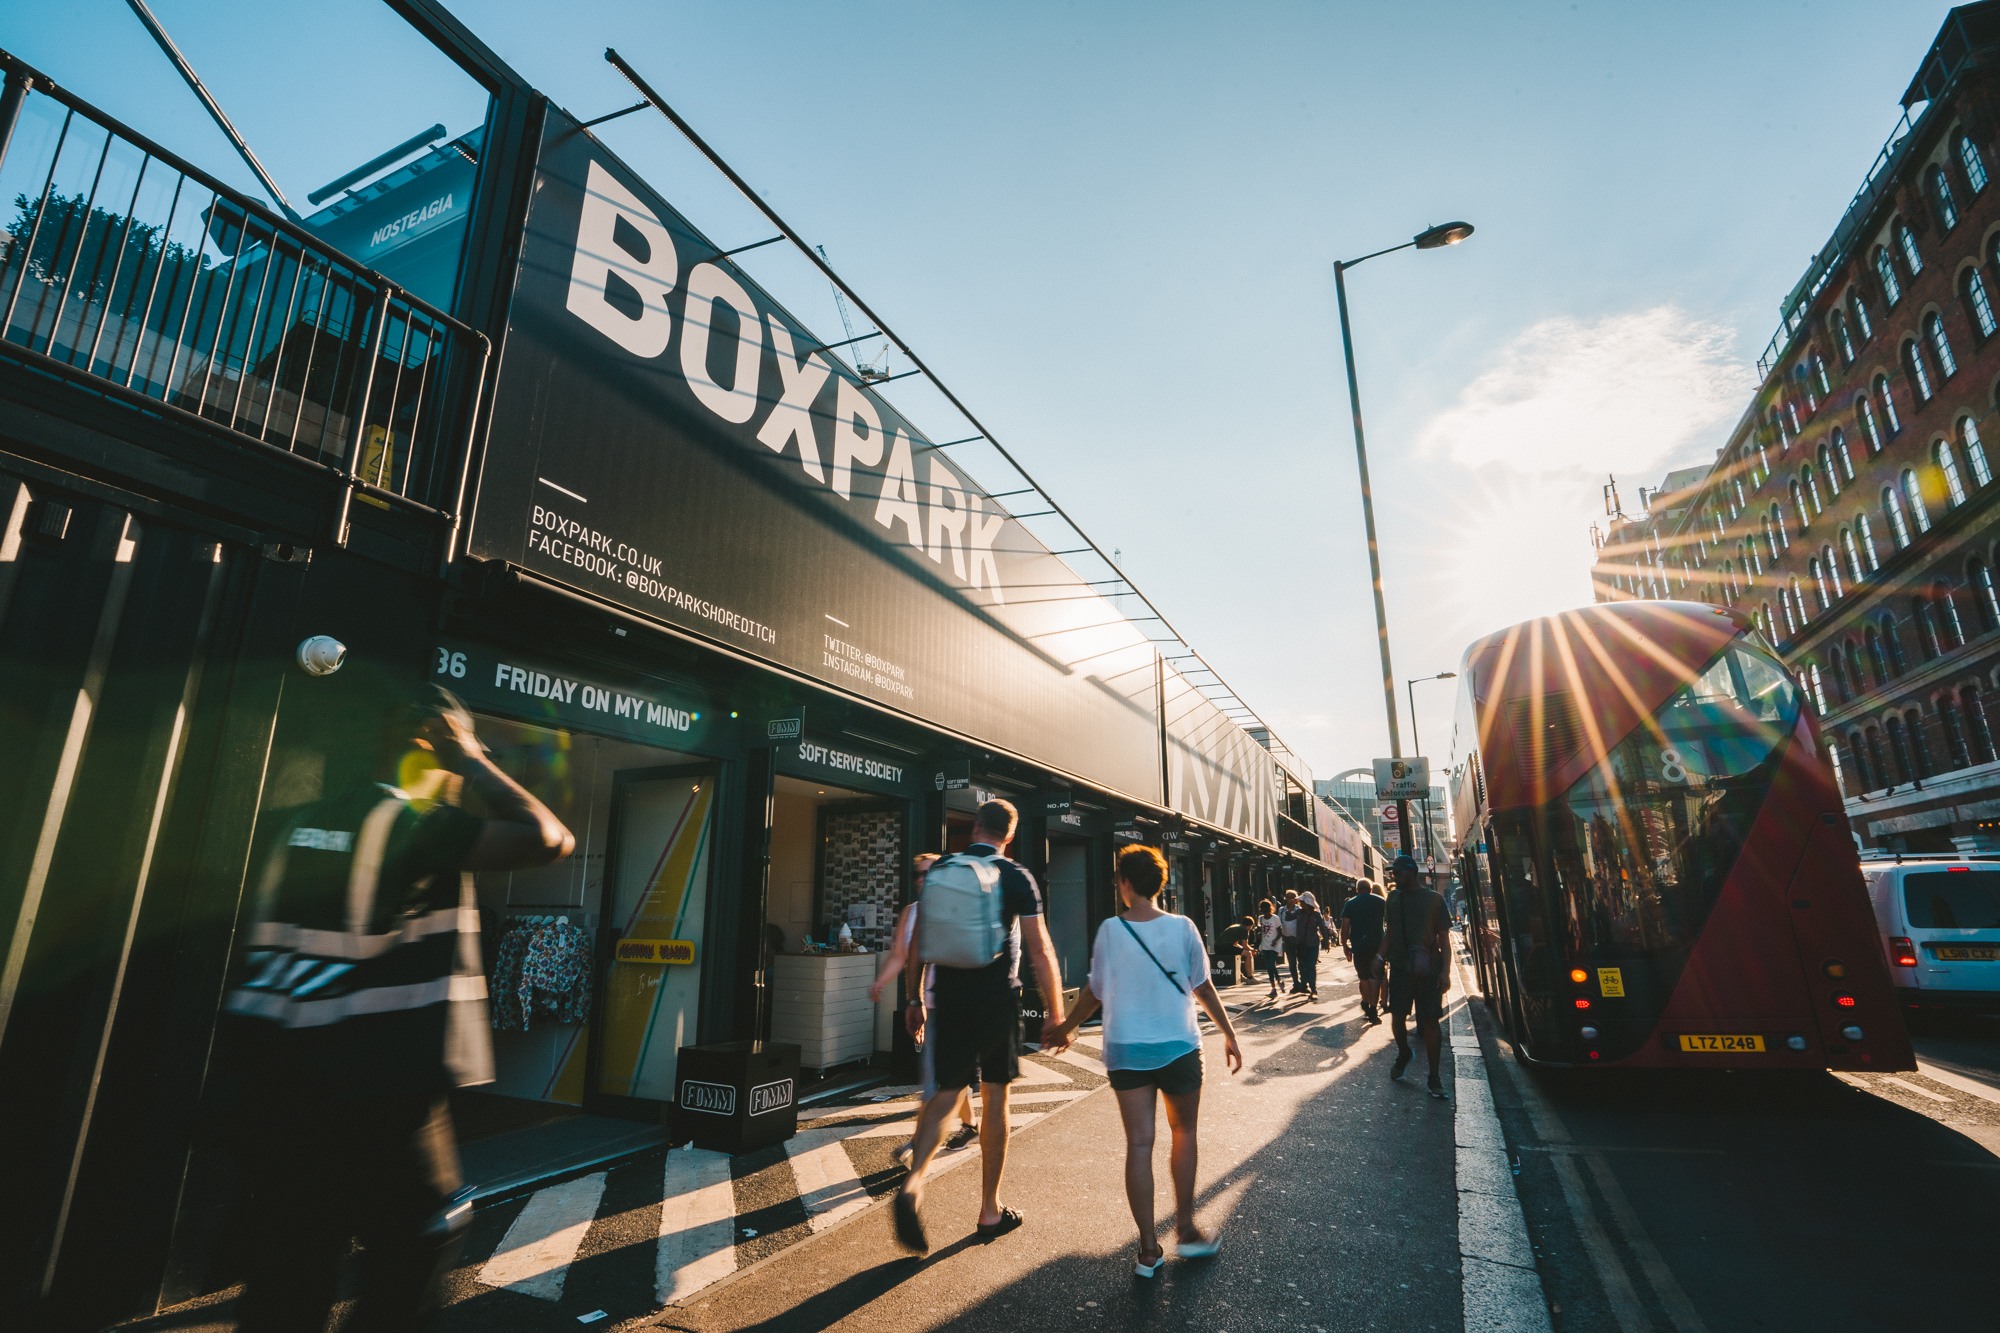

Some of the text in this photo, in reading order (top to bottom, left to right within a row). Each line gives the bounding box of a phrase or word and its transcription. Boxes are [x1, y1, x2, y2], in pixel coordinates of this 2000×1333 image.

[370, 193, 453, 247] NOSTEAGIA
[566, 159, 1005, 607] BOXPARK
[532, 505, 662, 577] BOXPARK.CO.UK
[529, 530, 776, 645] FACEBOOK: @BOXPARKSHOREDITCH
[823, 651, 914, 700] INSTAGRAM: @BOXPARK
[824, 634, 905, 681] TWITTER: @BOXPARK
[494, 663, 690, 731] FRIDAY ON MY MIND
[799, 742, 903, 783] SOFT SERVE SOCIETY
[1660, 749, 1687, 783] 8
[1381, 788, 1428, 797] enforcement
[1391, 781, 1417, 789] Traffic
[1971, 949, 1997, 959] CXZ
[1022, 1009, 1049, 1019] NO.P
[1688, 1036, 1756, 1050] LTZ 1248
[684, 1084, 733, 1111] FOMM
[752, 1082, 791, 1112] FOMM
